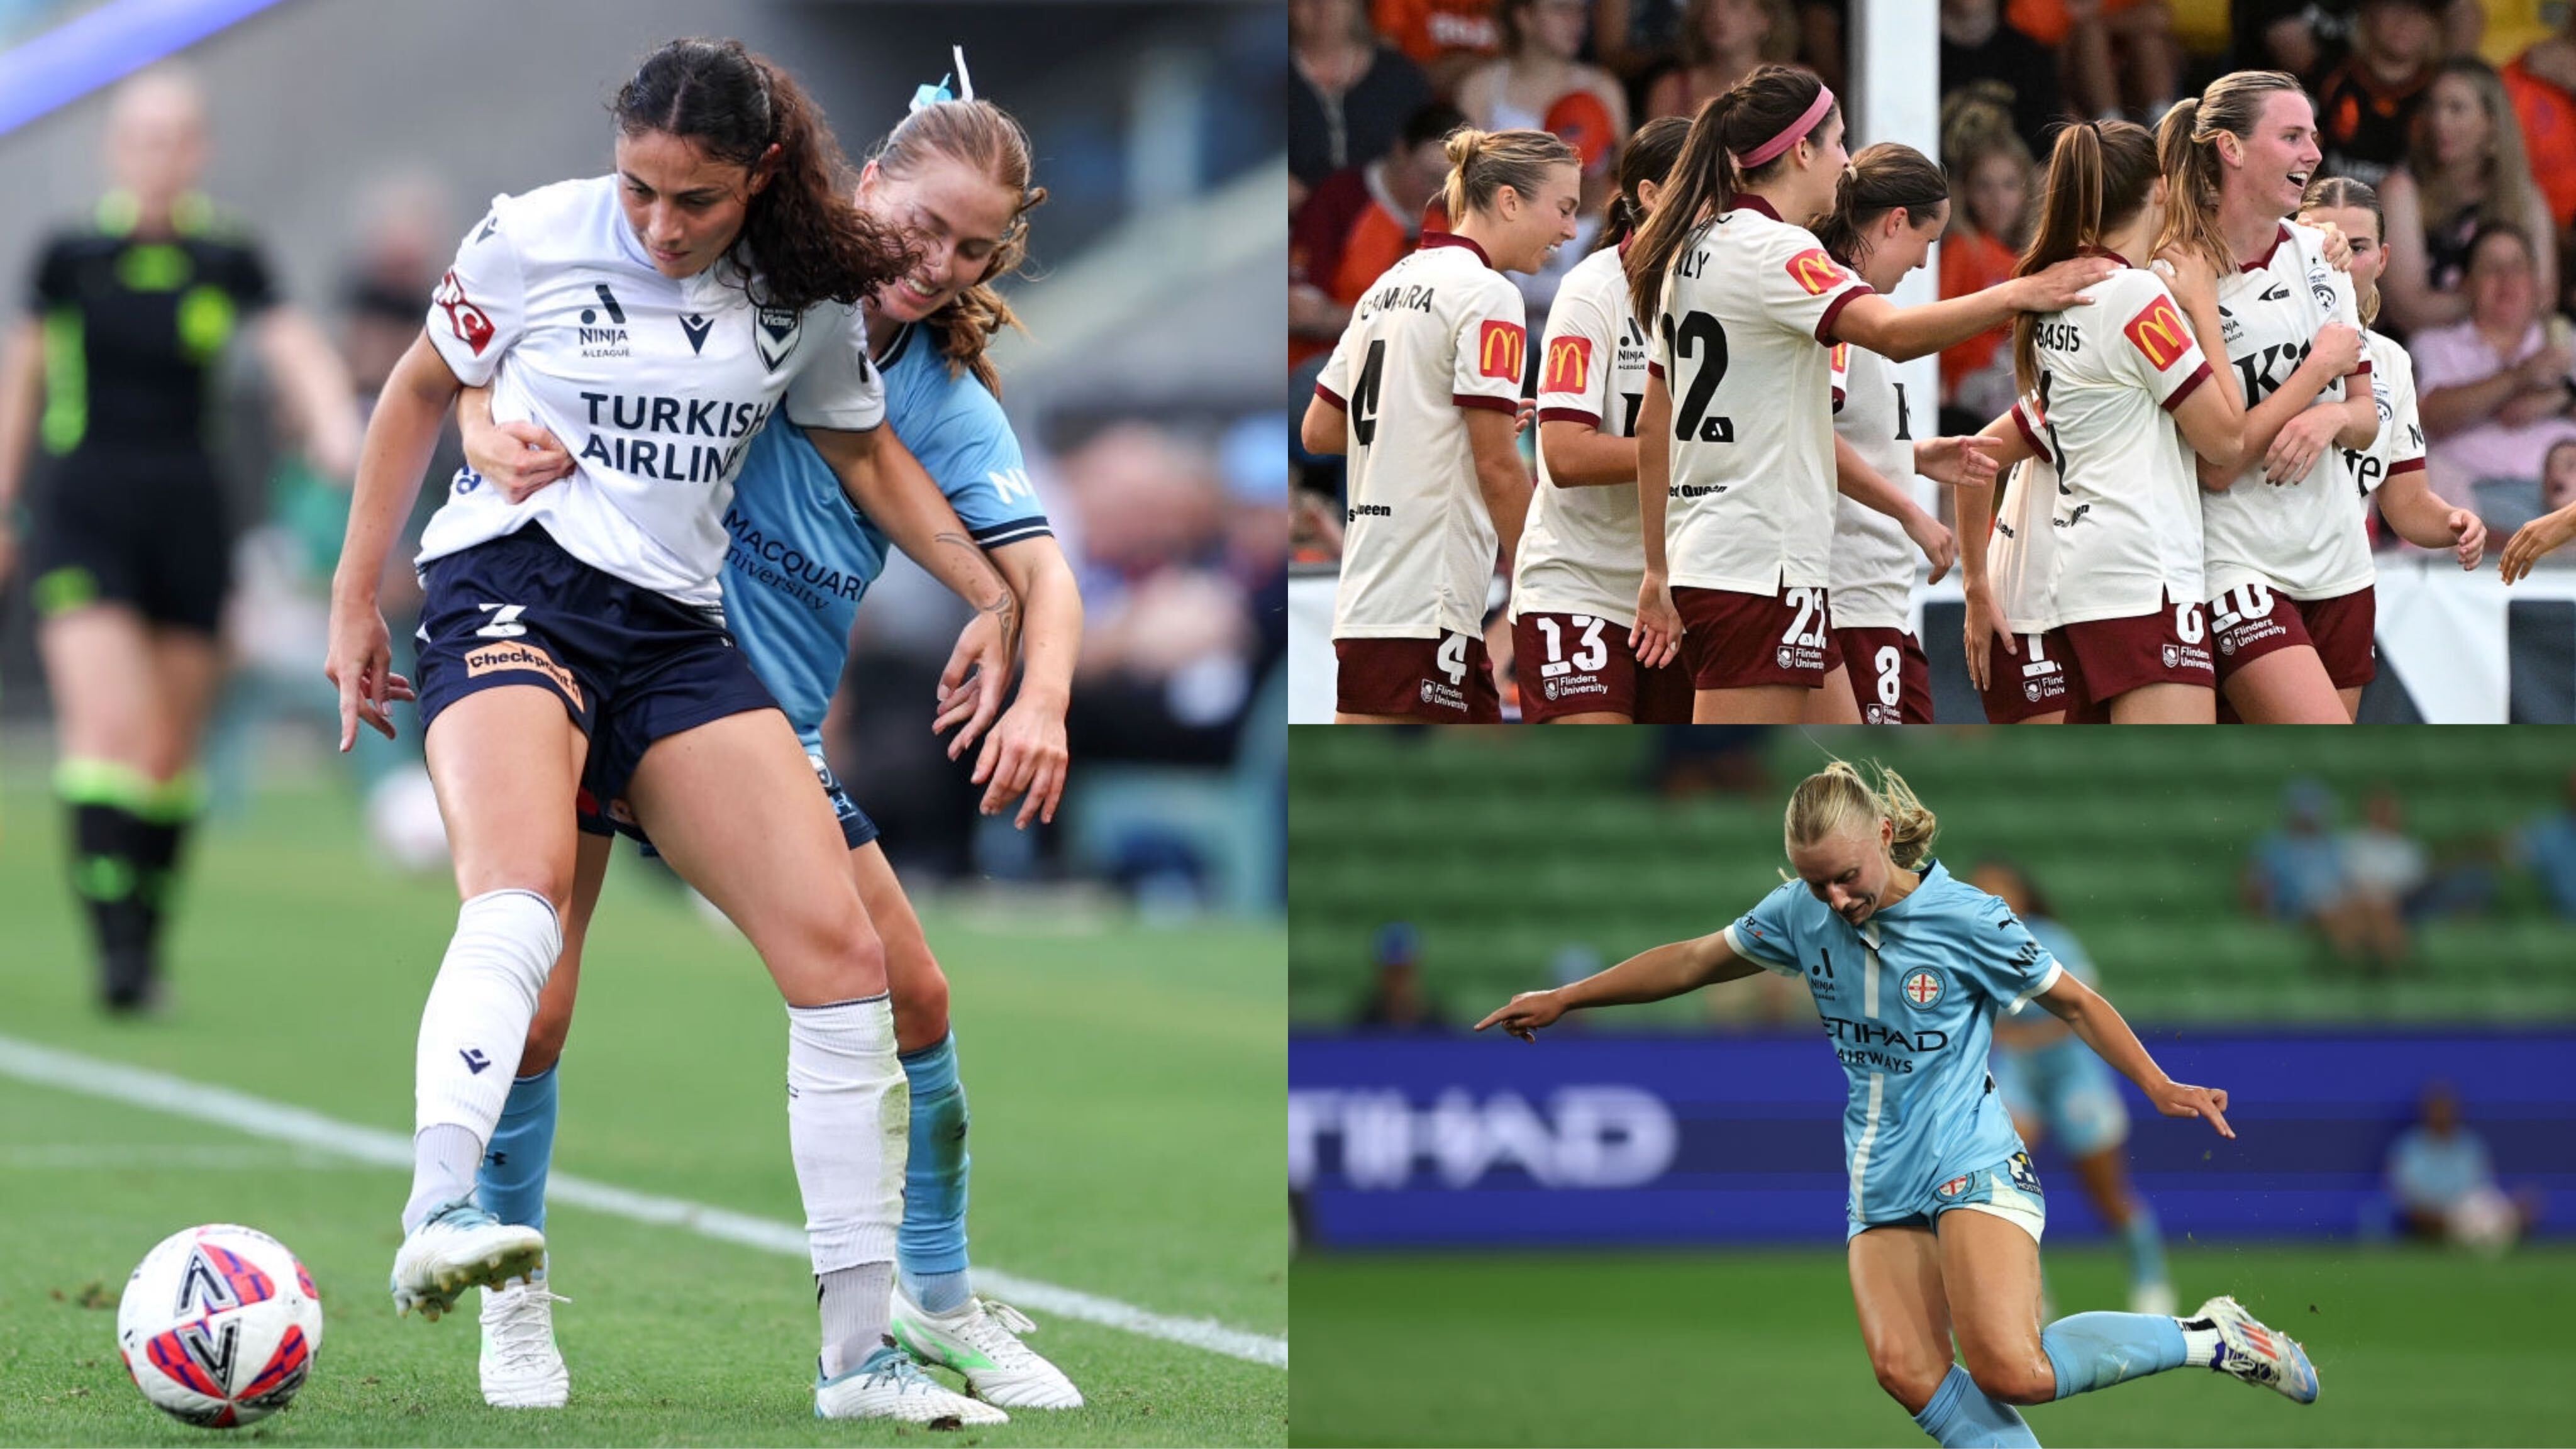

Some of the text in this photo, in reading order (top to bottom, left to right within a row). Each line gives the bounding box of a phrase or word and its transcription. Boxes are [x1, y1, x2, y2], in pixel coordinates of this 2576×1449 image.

[579, 327, 628, 345] NINJA
[1619, 348, 1645, 362] NINJA
[580, 391, 771, 439] TURKISH
[2234, 619, 2273, 638] Flinders
[2237, 626, 2286, 647] University
[1536, 616, 1608, 677] 13
[2022, 633, 2062, 677] 1
[1437, 632, 1468, 686] 4
[1560, 675, 1597, 686] Flinders
[1875, 645, 1901, 707] 8
[1560, 683, 1608, 696] University
[1811, 977, 1835, 992] NINJA
[1821, 1015, 1948, 1052] ETIHAD
[1836, 1048, 1914, 1074] AIRWAYS
